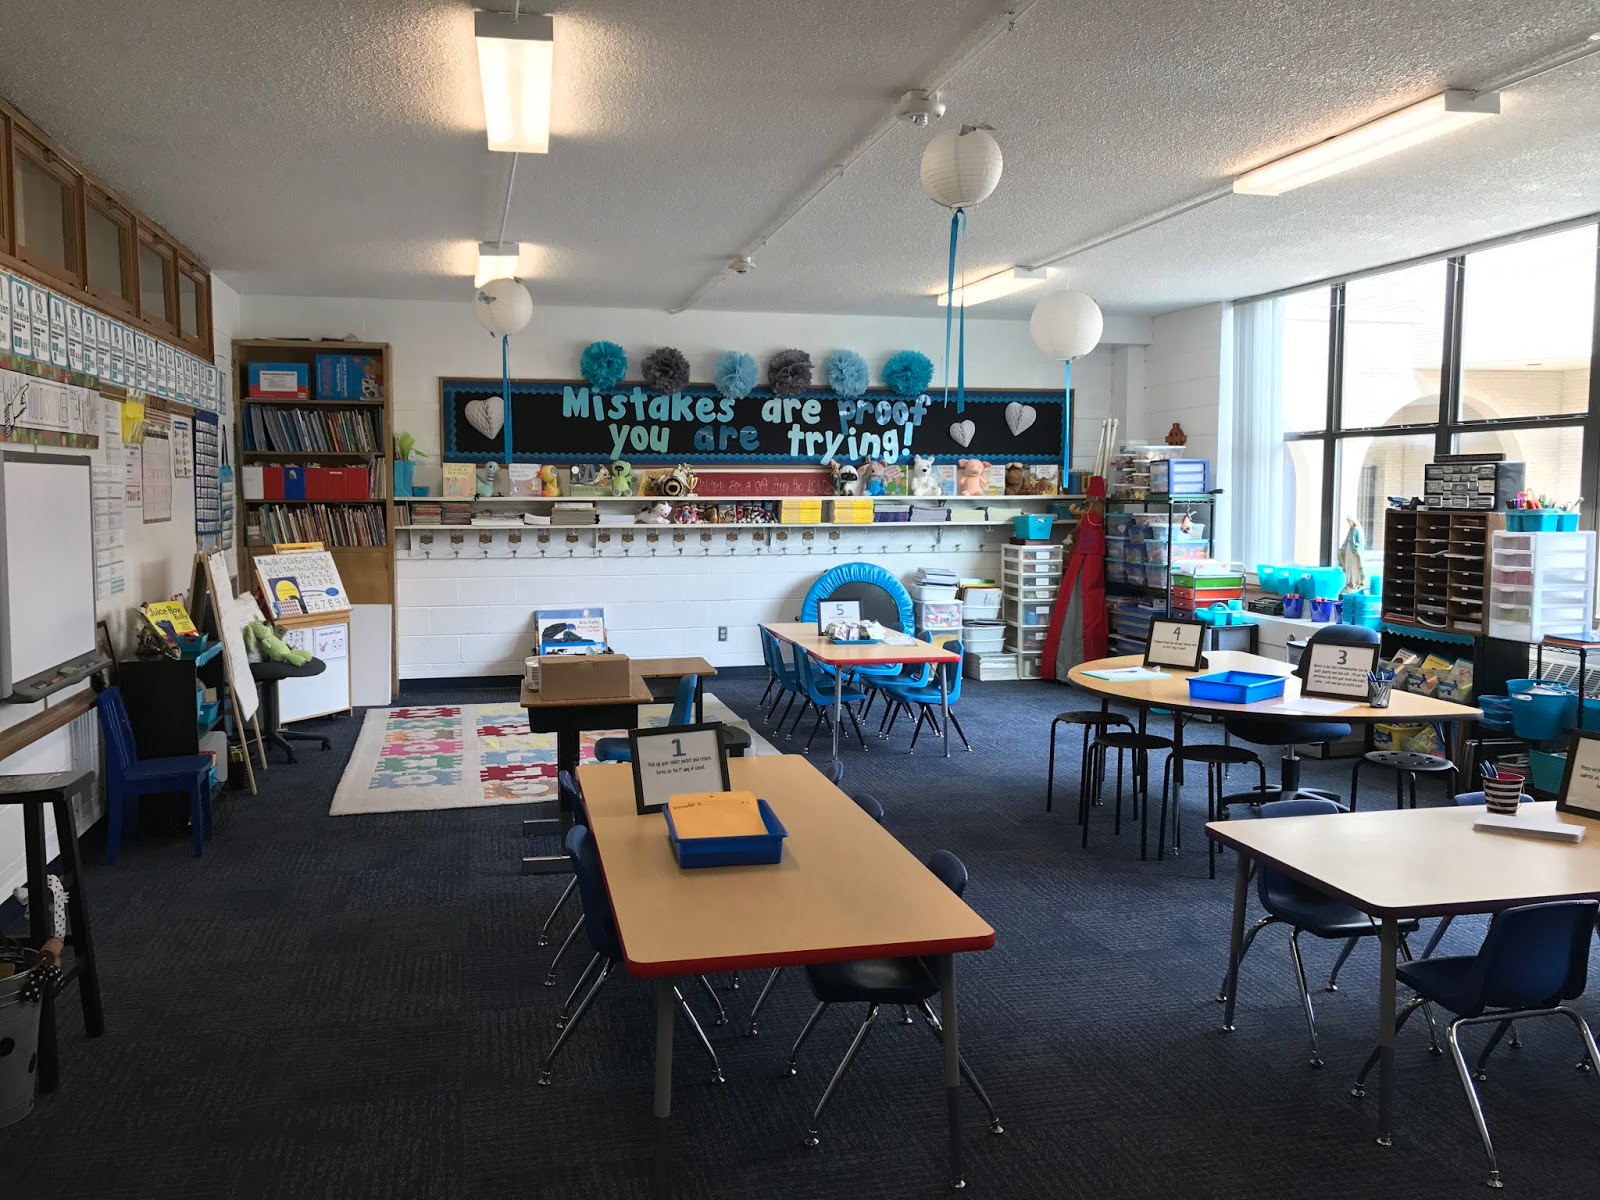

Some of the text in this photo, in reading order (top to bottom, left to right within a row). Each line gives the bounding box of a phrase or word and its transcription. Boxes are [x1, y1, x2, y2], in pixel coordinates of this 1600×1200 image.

[16, 283, 24, 307] 12
[35, 291, 43, 313] 13
[54, 300, 61, 321] 14
[69, 307, 77, 328] 15
[86, 314, 93, 335] 16
[562, 386, 932, 436] Mistakes are proof
[608, 422, 913, 465] you are trying!
[698, 478, 725, 494] hildren
[166, 605, 182, 614] Box
[307, 601, 313, 610] 5
[315, 601, 320, 609] 6
[321, 600, 325, 608] 7
[328, 599, 334, 607] 8
[836, 603, 845, 616] 5
[172, 611, 188, 620] Bully
[1173, 626, 1182, 641] 4
[1337, 649, 1348, 665] 3
[671, 738, 686, 757] 1
